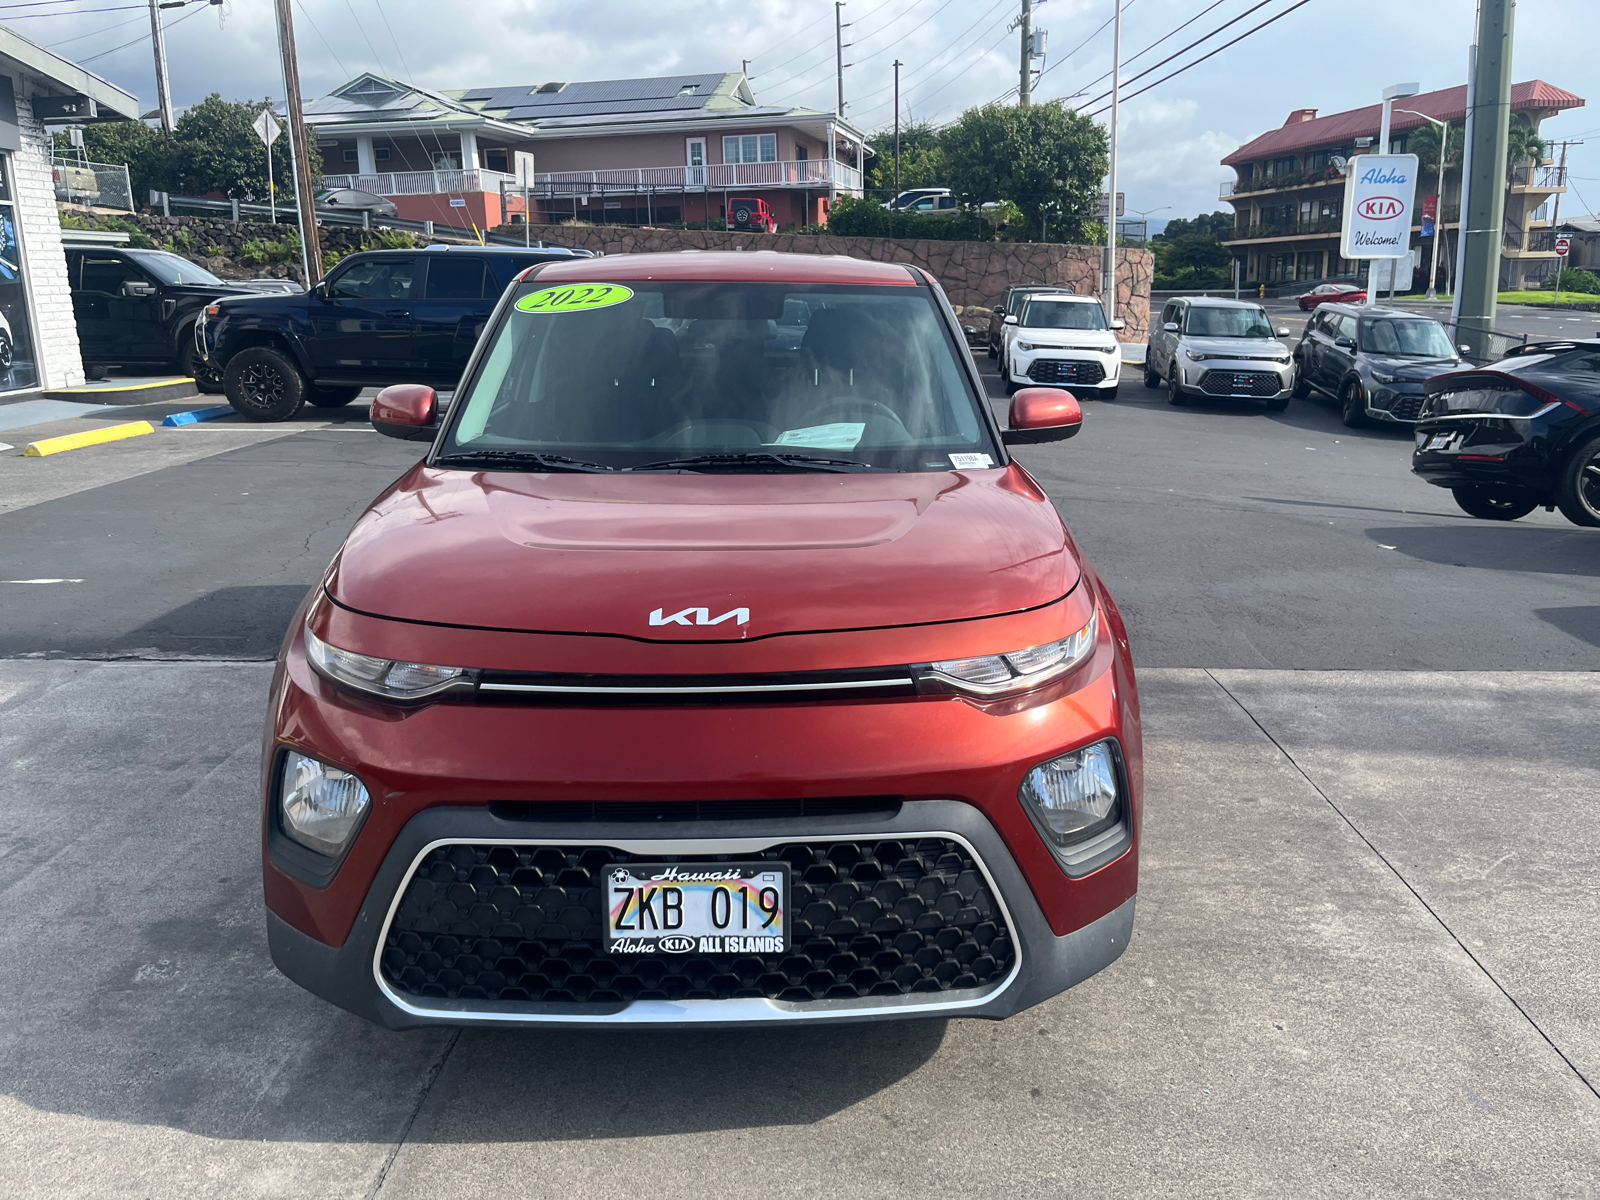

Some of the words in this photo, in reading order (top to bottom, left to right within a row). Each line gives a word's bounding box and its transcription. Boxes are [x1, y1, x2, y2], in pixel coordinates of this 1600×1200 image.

[1360, 168, 1407, 184] Aloha
[1365, 202, 1397, 215] KIA
[1355, 230, 1402, 246] Welcome!
[529, 287, 613, 309] 2022
[651, 866, 742, 882] Hawaii
[614, 887, 684, 931] ZKB
[711, 886, 779, 930] 019
[610, 938, 656, 954] Aloha
[665, 939, 690, 950] KIA
[699, 937, 723, 954] ALL
[724, 936, 784, 953] ISLANDS
